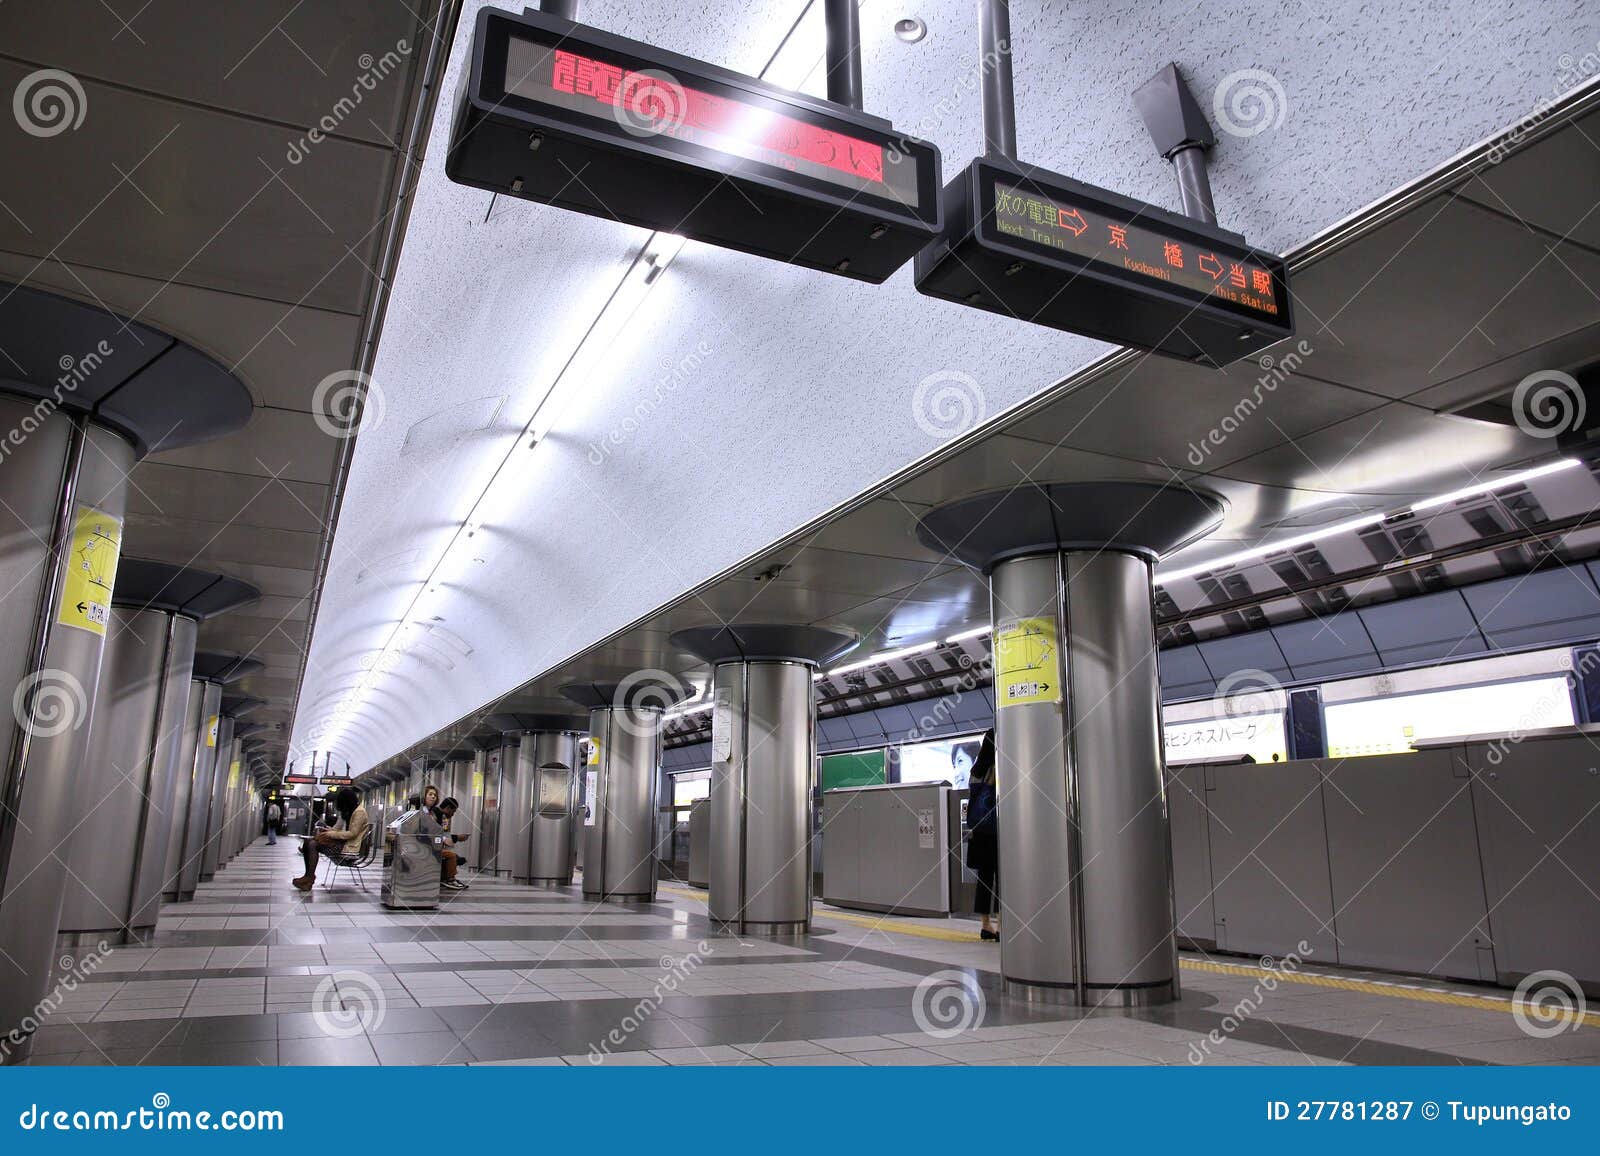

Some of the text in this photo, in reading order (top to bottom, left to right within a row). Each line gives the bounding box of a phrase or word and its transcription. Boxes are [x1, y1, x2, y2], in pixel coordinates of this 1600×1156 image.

[995, 190, 1059, 228] 次の電車
[1230, 263, 1272, 297] 当駅
[997, 219, 1279, 315] Next Train Kyobashi This Station
